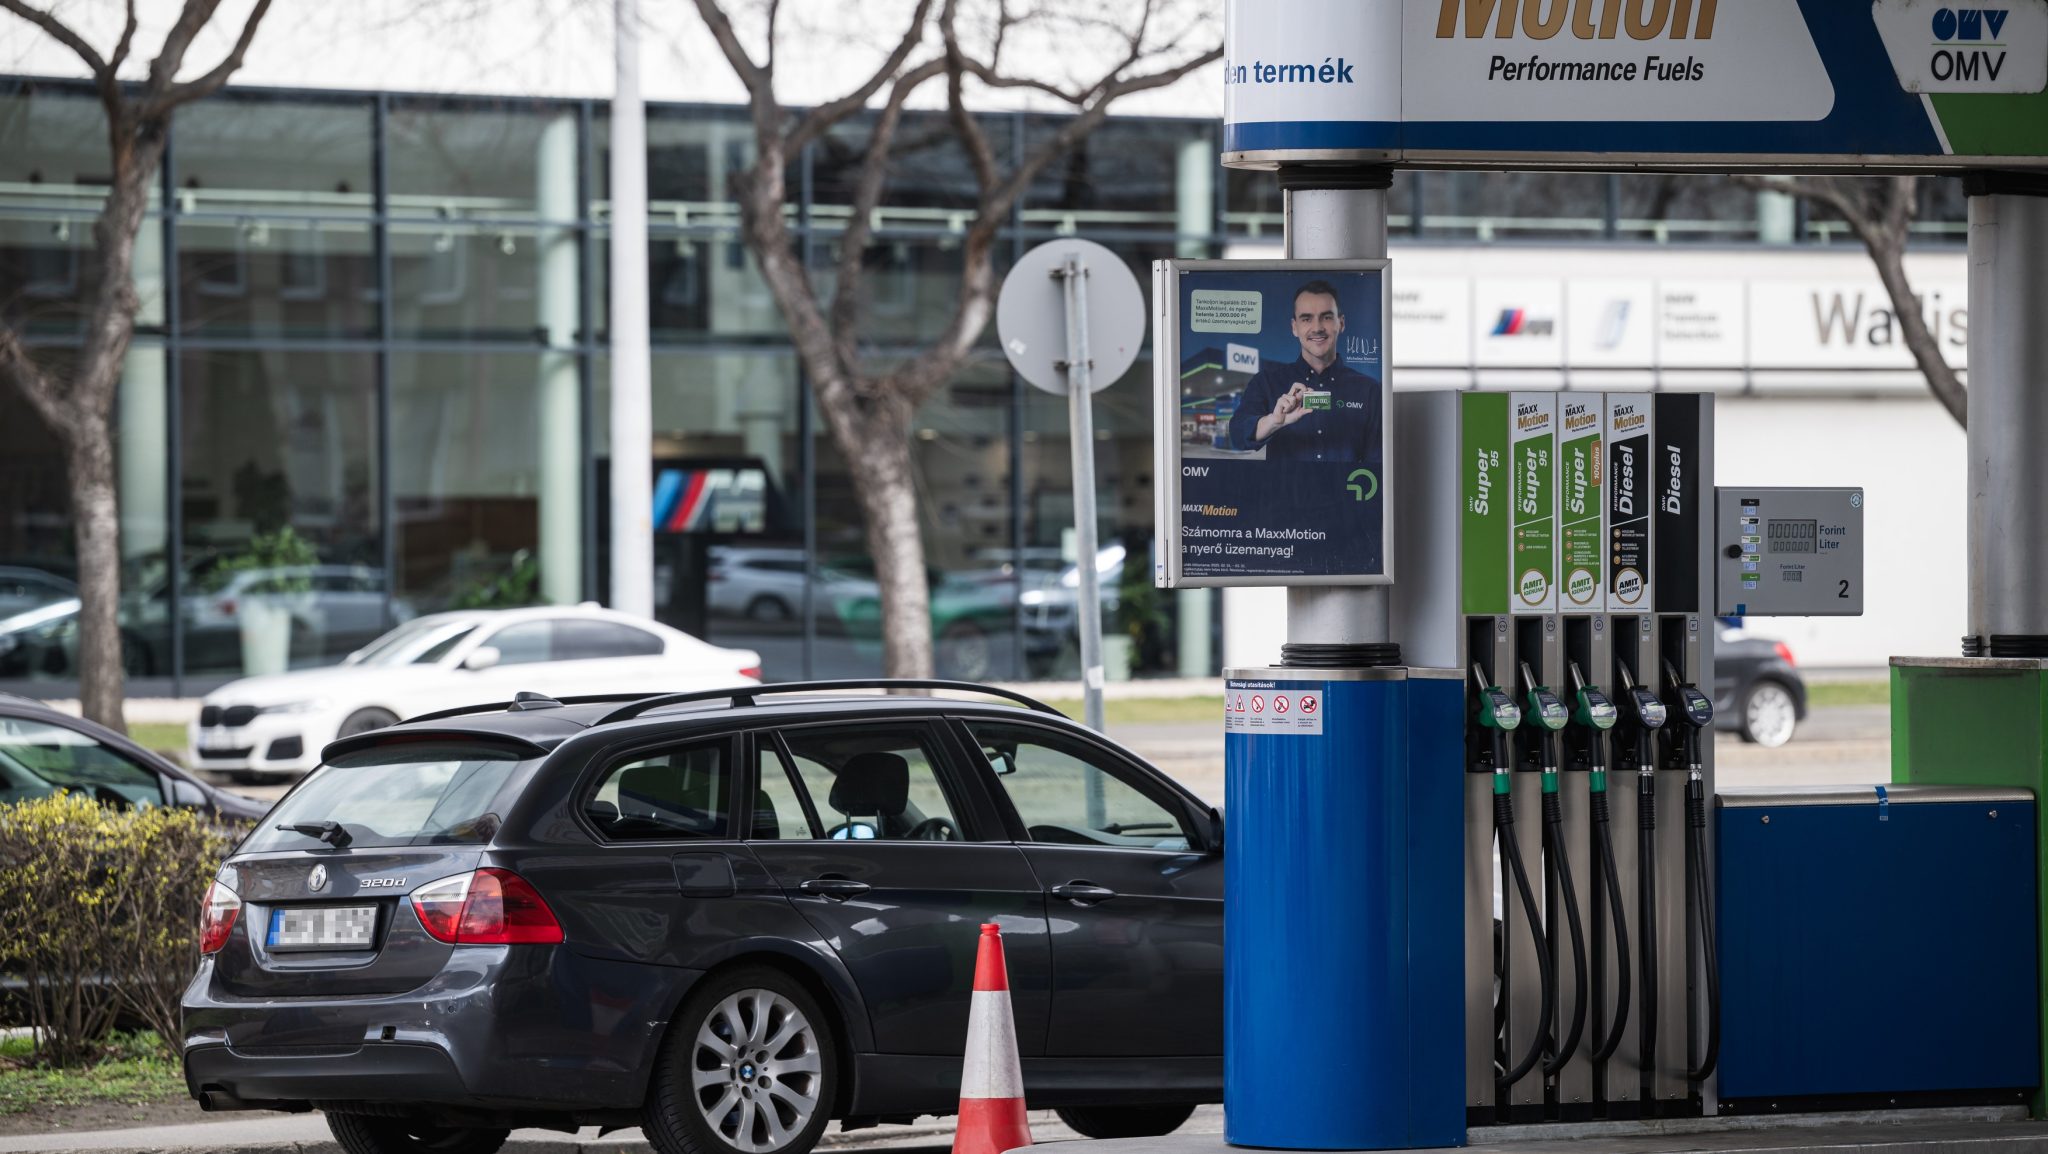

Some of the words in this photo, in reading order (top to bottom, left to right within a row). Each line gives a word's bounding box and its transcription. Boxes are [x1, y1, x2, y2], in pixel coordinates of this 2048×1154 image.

[1253, 57, 1354, 84] termék
[1488, 55, 1637, 81] Performance
[1643, 56, 1705, 81] Fuels
[1931, 50, 2006, 81] OMV
[1812, 291, 1968, 346] Wais
[1233, 352, 1256, 366] OMV
[1346, 401, 1364, 409] OMV
[1518, 404, 1538, 416] MAXX
[1565, 404, 1585, 417] MAXX
[1614, 405, 1634, 418] MAXX
[1518, 413, 1549, 430] Motion
[1565, 413, 1596, 430] Motion
[1614, 414, 1645, 430] Motion
[1491, 450, 1499, 468] 95
[1539, 450, 1548, 467] 95
[1182, 466, 1210, 477] OMV
[1475, 448, 1492, 516] Super
[1523, 448, 1540, 515] Super
[1571, 448, 1588, 515] Super
[1619, 445, 1634, 515] Diesel
[1667, 445, 1681, 515] Diesel
[1182, 526, 1242, 538] Számomra
[1245, 530, 1252, 538] a
[1255, 528, 1326, 540] MaxxMotion
[1819, 525, 1846, 535] Forint
[1182, 545, 1187, 553] a
[1190, 543, 1222, 556] nyerő
[1225, 543, 1294, 559] üzemanyag!
[1819, 539, 1840, 549] Liter
[1523, 578, 1543, 590] AMIT
[1571, 577, 1591, 589] AMIT
[1619, 577, 1639, 590] AMIT
[1838, 580, 1849, 598] 2
[360, 878, 407, 888] 320d
